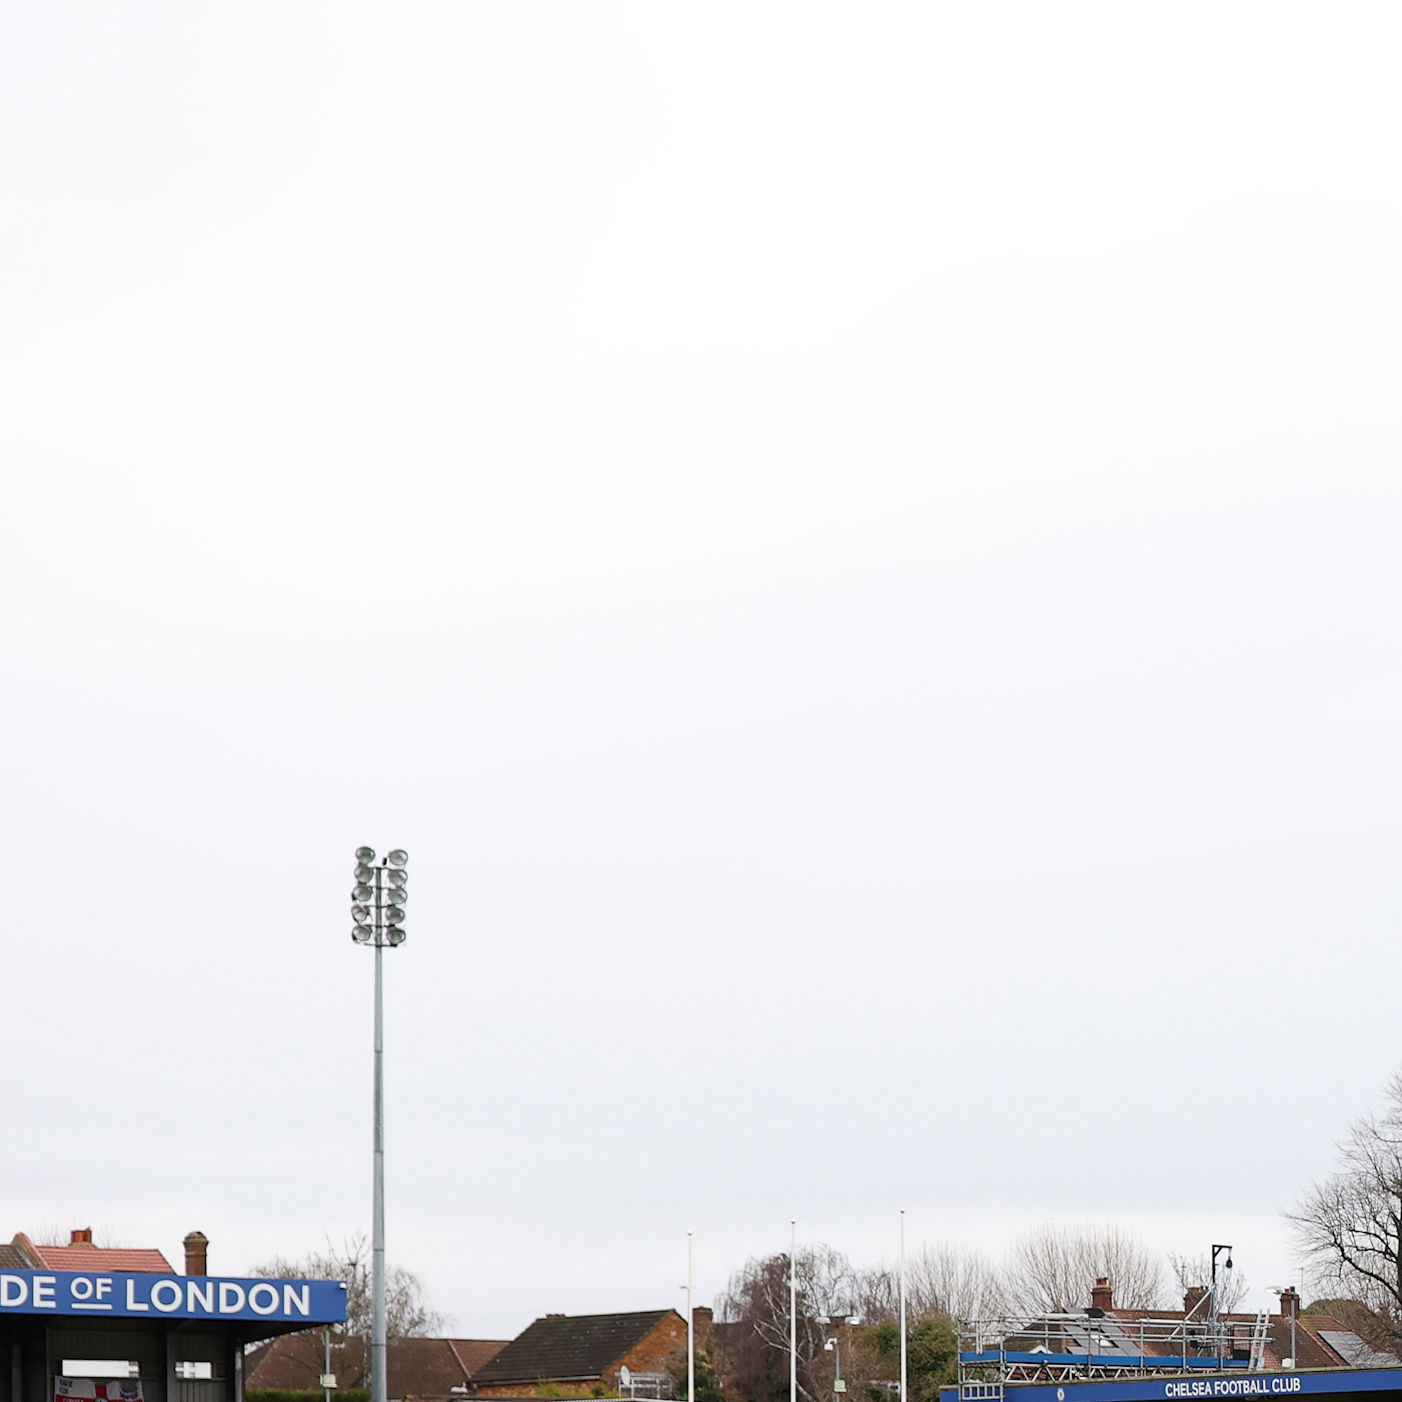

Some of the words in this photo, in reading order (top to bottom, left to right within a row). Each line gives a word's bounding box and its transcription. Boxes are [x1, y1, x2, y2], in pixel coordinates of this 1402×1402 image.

[70, 1276, 112, 1300] OF
[126, 1278, 310, 1316] LONDON
[1165, 1381, 1213, 1397] CHELSEA
[1214, 1379, 1270, 1395] FOOTBALL
[1271, 1377, 1300, 1393] CLUB
